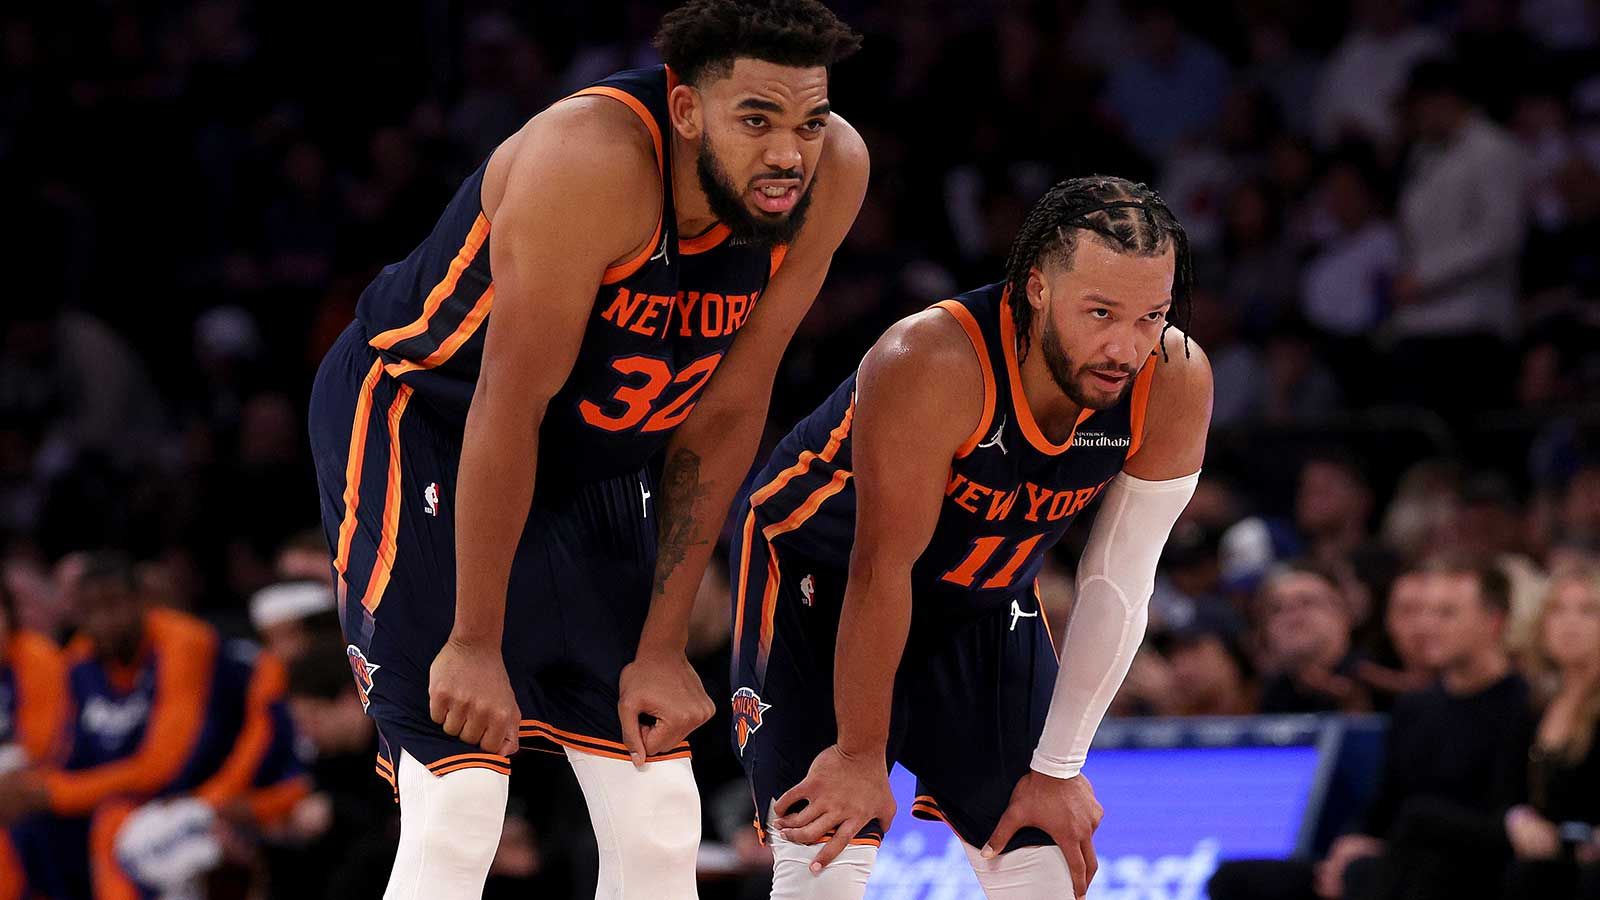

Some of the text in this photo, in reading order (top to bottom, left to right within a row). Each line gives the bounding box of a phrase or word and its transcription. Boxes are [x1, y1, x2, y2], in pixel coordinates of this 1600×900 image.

[601, 287, 676, 340] NE
[578, 353, 723, 433] 32
[1095, 437, 1130, 447] dhabi
[941, 534, 1045, 589] 11
